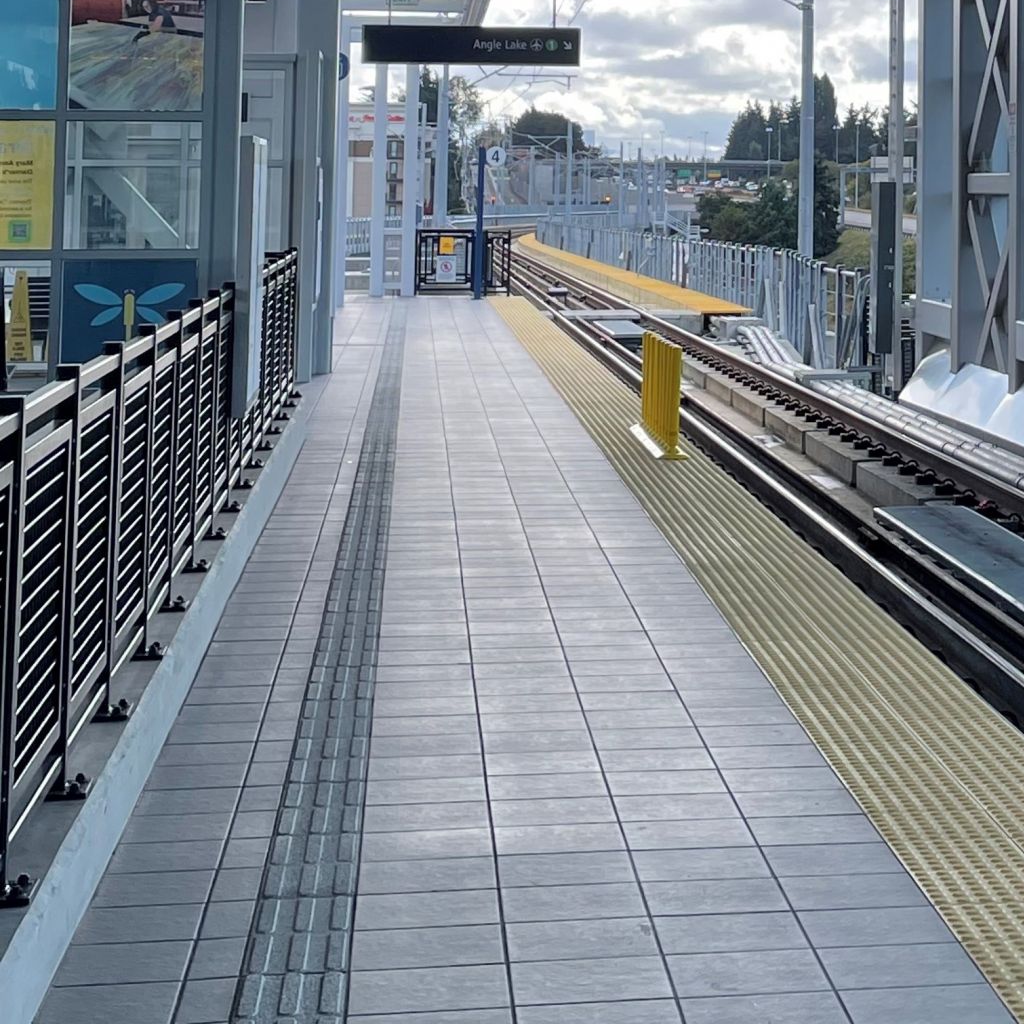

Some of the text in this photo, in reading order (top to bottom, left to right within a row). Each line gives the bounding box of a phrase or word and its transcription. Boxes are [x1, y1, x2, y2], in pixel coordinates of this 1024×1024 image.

[473, 39, 501, 52] Angle
[505, 40, 527, 50] Lake
[491, 150, 500, 162] 4
